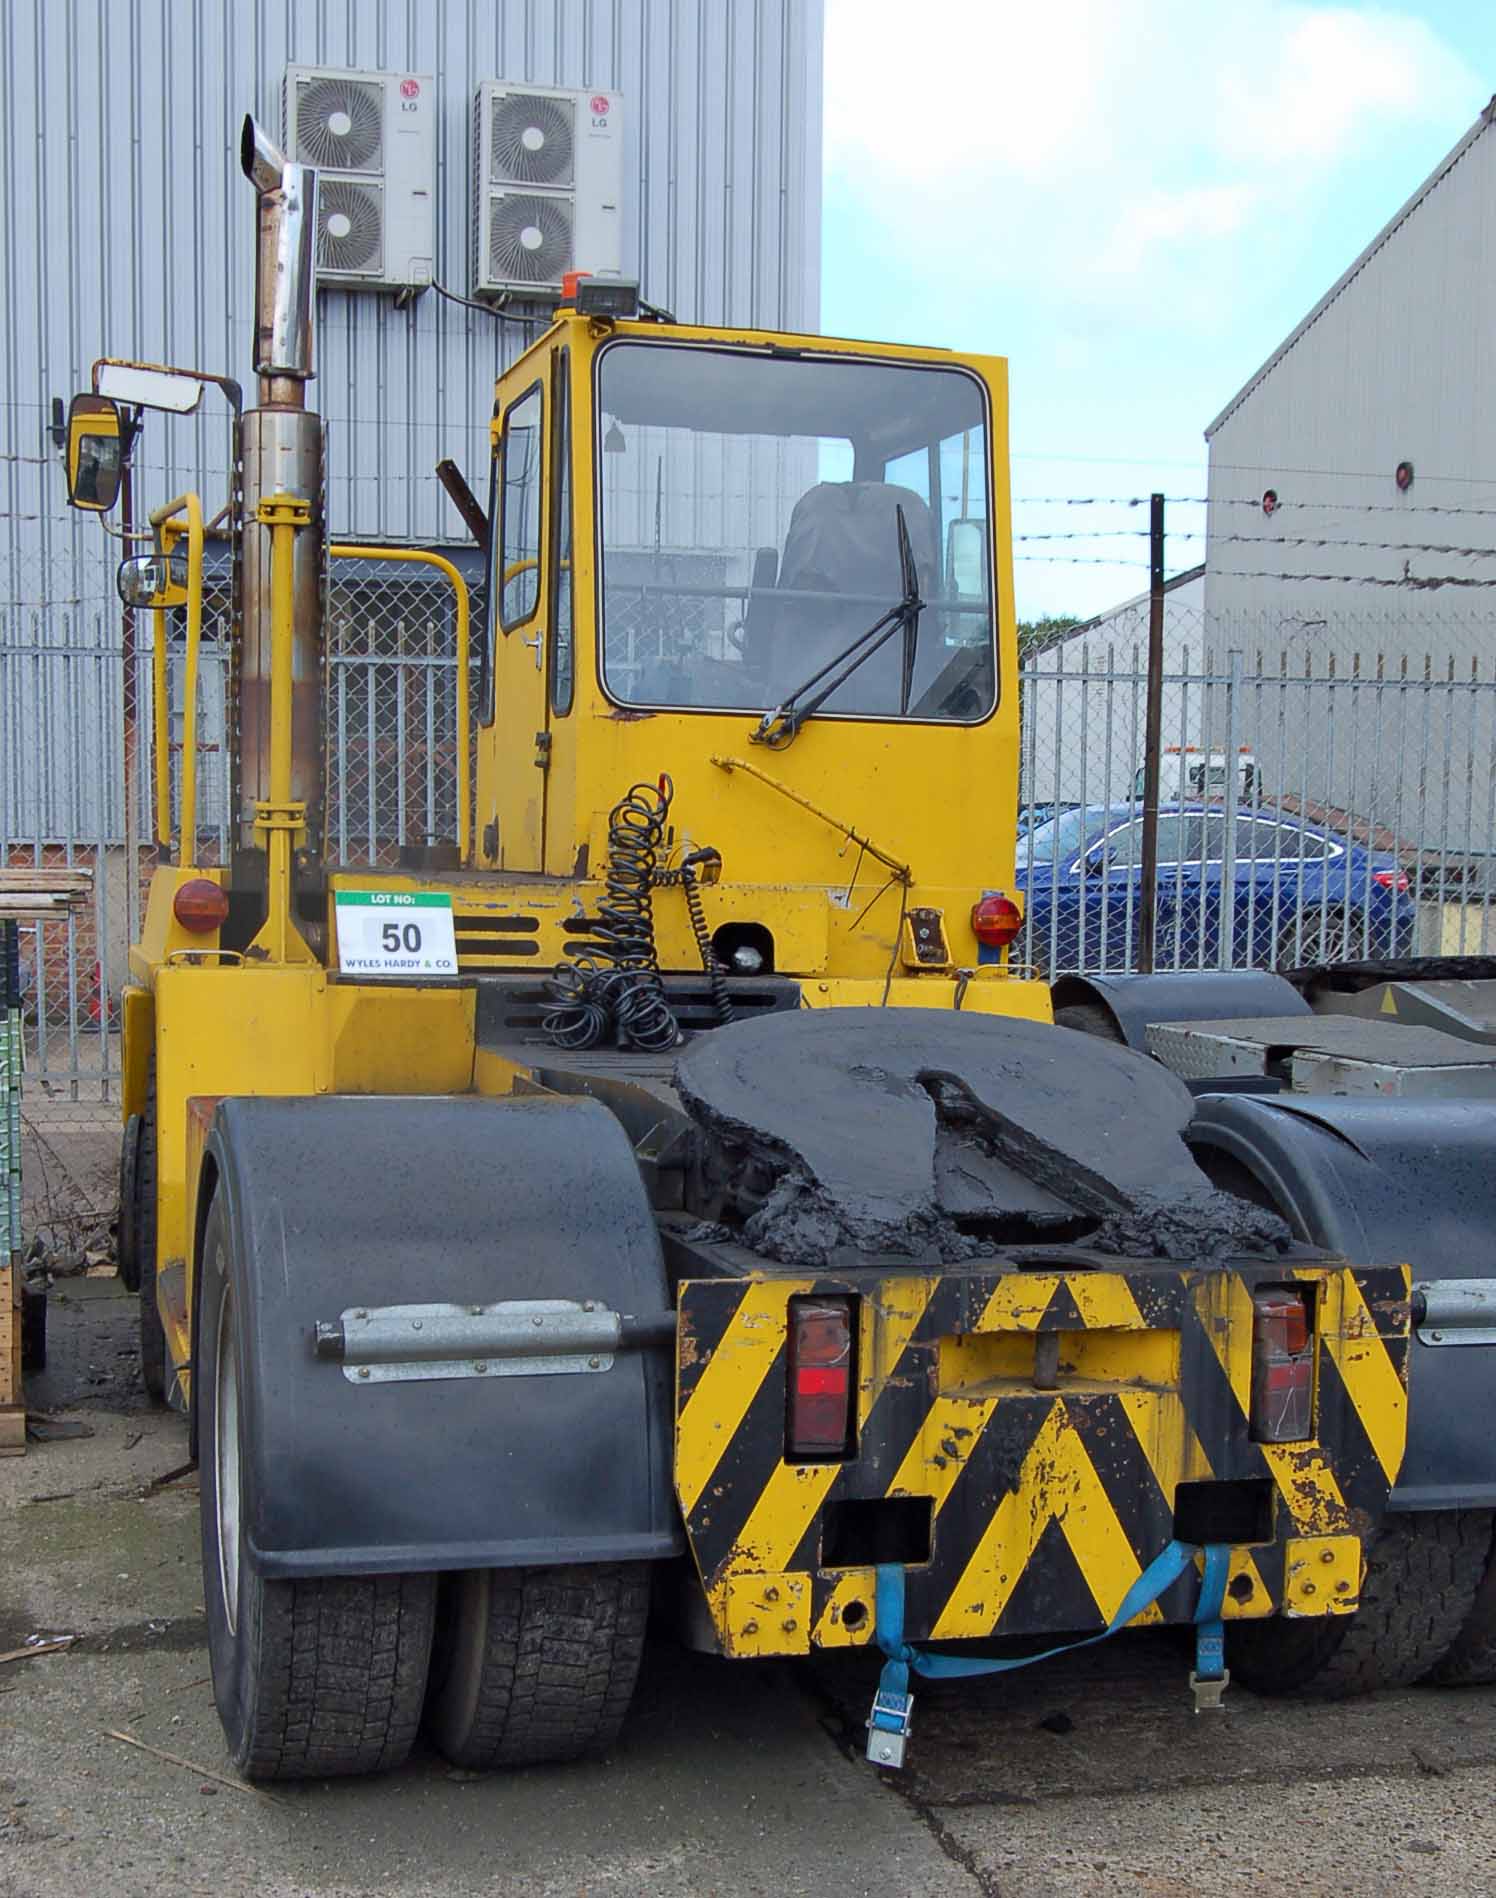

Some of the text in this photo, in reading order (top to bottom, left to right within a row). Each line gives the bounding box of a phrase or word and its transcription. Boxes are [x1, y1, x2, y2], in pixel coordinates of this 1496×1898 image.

[402, 102, 417, 112] LG
[592, 118, 607, 128] LG
[371, 894, 416, 905] LOT NO:
[382, 923, 422, 953] 50
[345, 959, 381, 968] WYLES
[384, 959, 421, 968] HARDY
[424, 959, 432, 968] &
